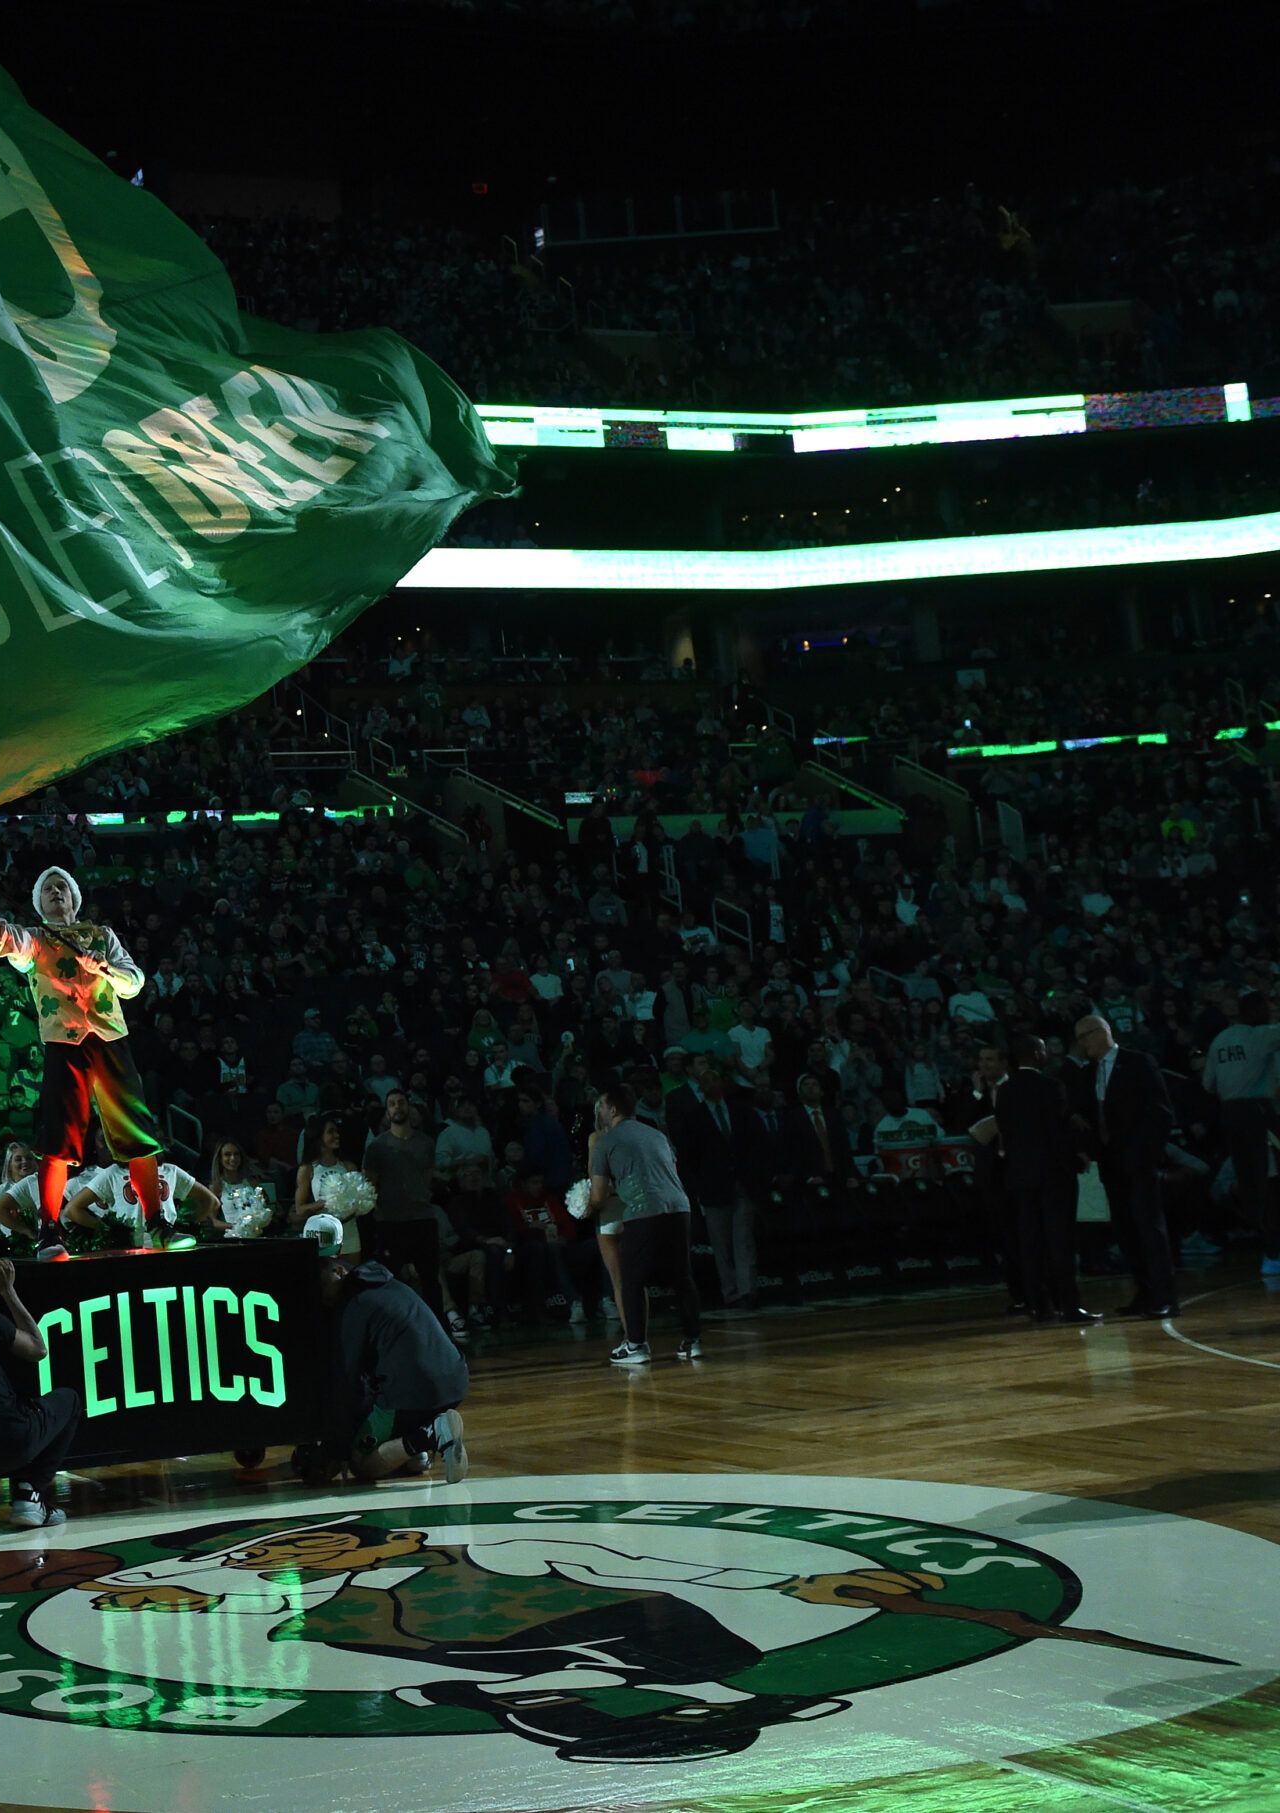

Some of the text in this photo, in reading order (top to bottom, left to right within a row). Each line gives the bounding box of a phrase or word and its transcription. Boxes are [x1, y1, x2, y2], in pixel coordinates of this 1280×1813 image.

[10, 1010, 21, 1026] 7
[37, 1286, 287, 1419] CELTICS
[30, 1491, 40, 1502] N
[513, 1503, 1042, 1575] CELTICS
